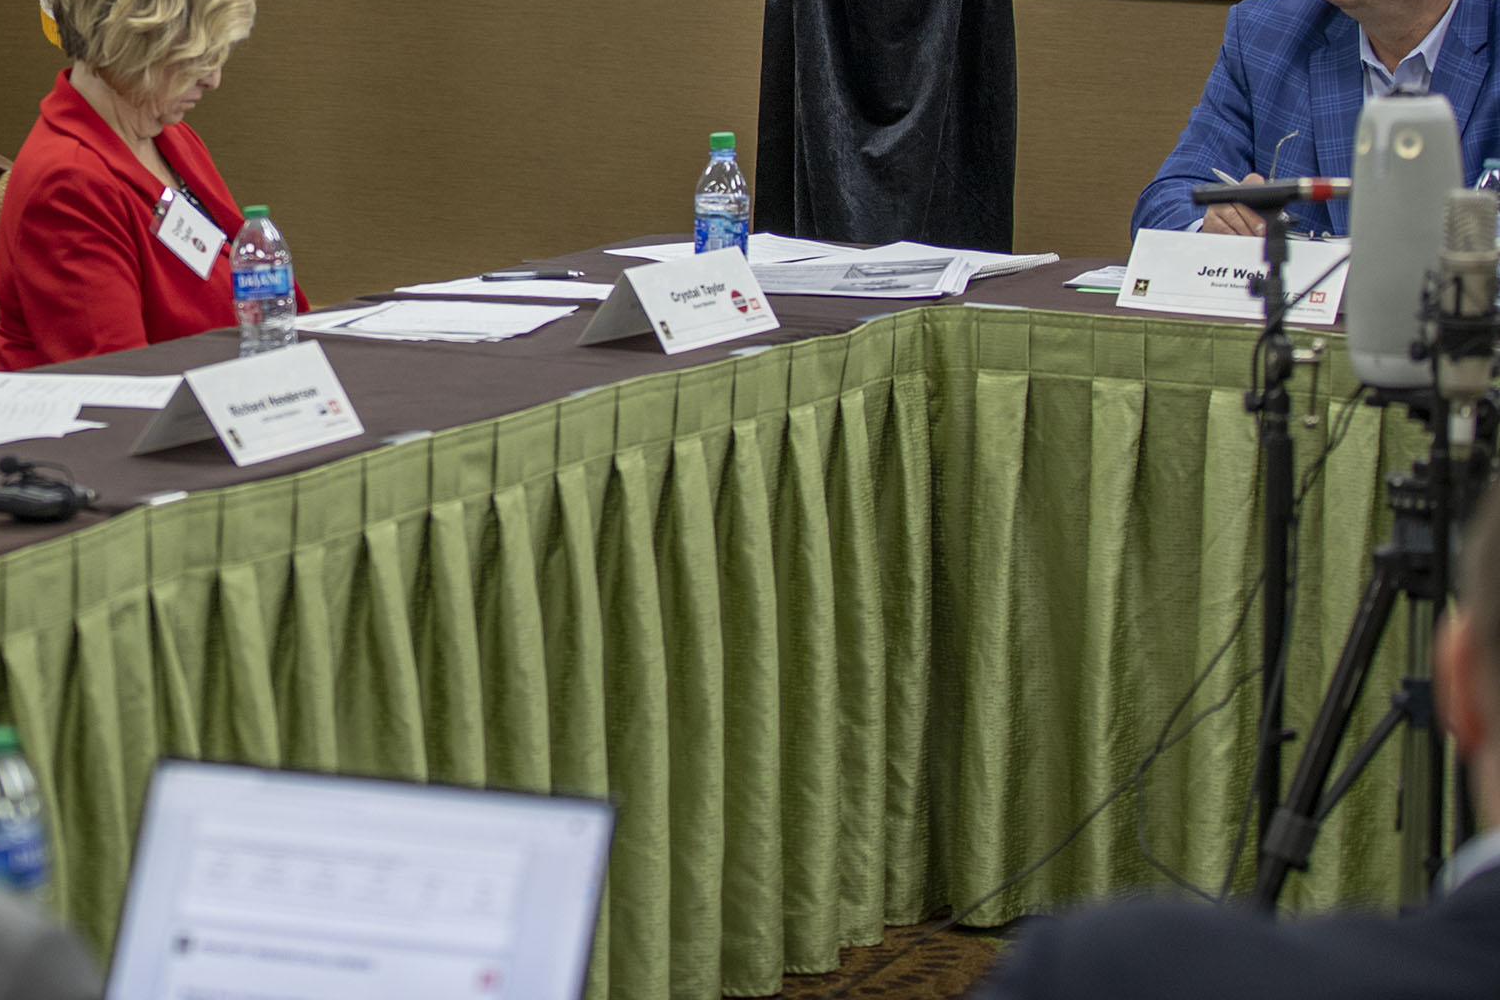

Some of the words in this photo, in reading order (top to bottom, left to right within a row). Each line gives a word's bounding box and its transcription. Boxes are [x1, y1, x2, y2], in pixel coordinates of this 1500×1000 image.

[1197, 265, 1228, 278] Jeff
[670, 287, 700, 303] Crystal
[700, 283, 726, 298] Taylor
